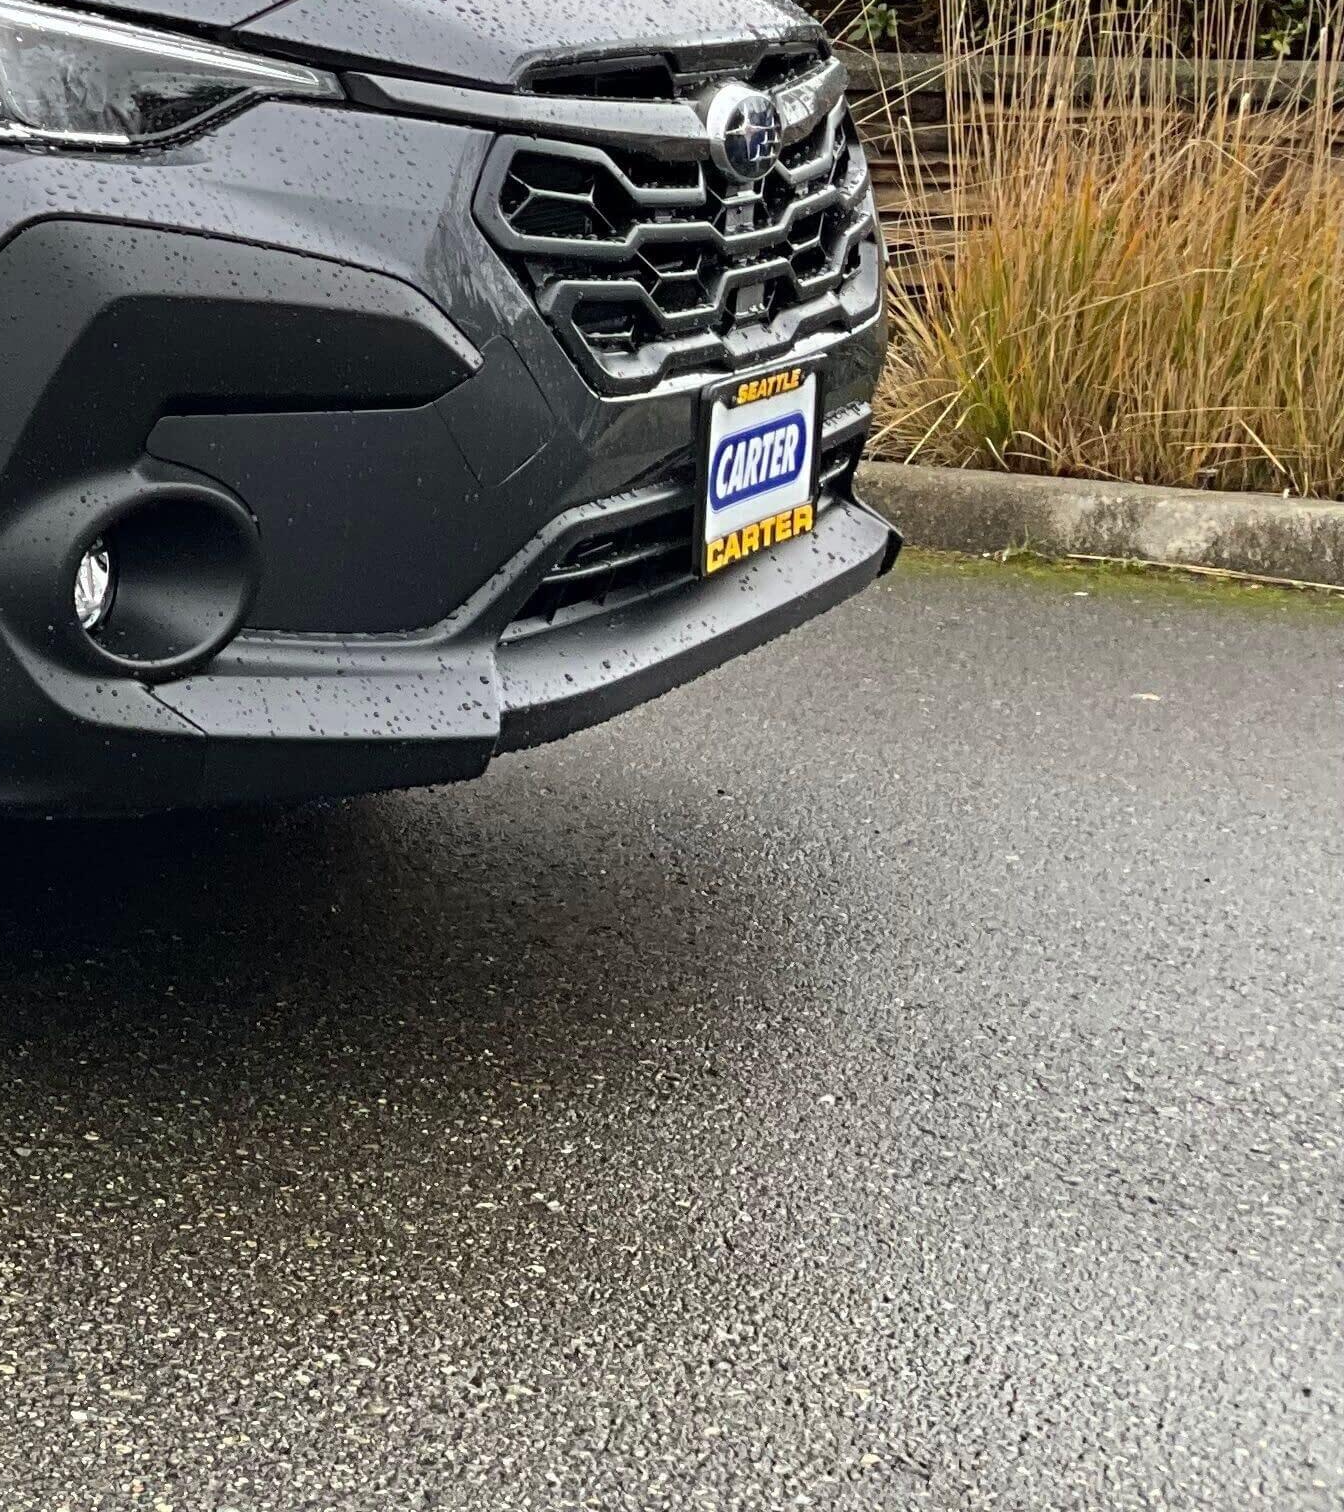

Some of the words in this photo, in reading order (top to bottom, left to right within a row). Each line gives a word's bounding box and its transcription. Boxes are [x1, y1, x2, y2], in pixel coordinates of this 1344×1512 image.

[736, 368, 802, 405] SEATTLE
[715, 423, 800, 500] CARTER
[706, 504, 814, 573] CARTER
